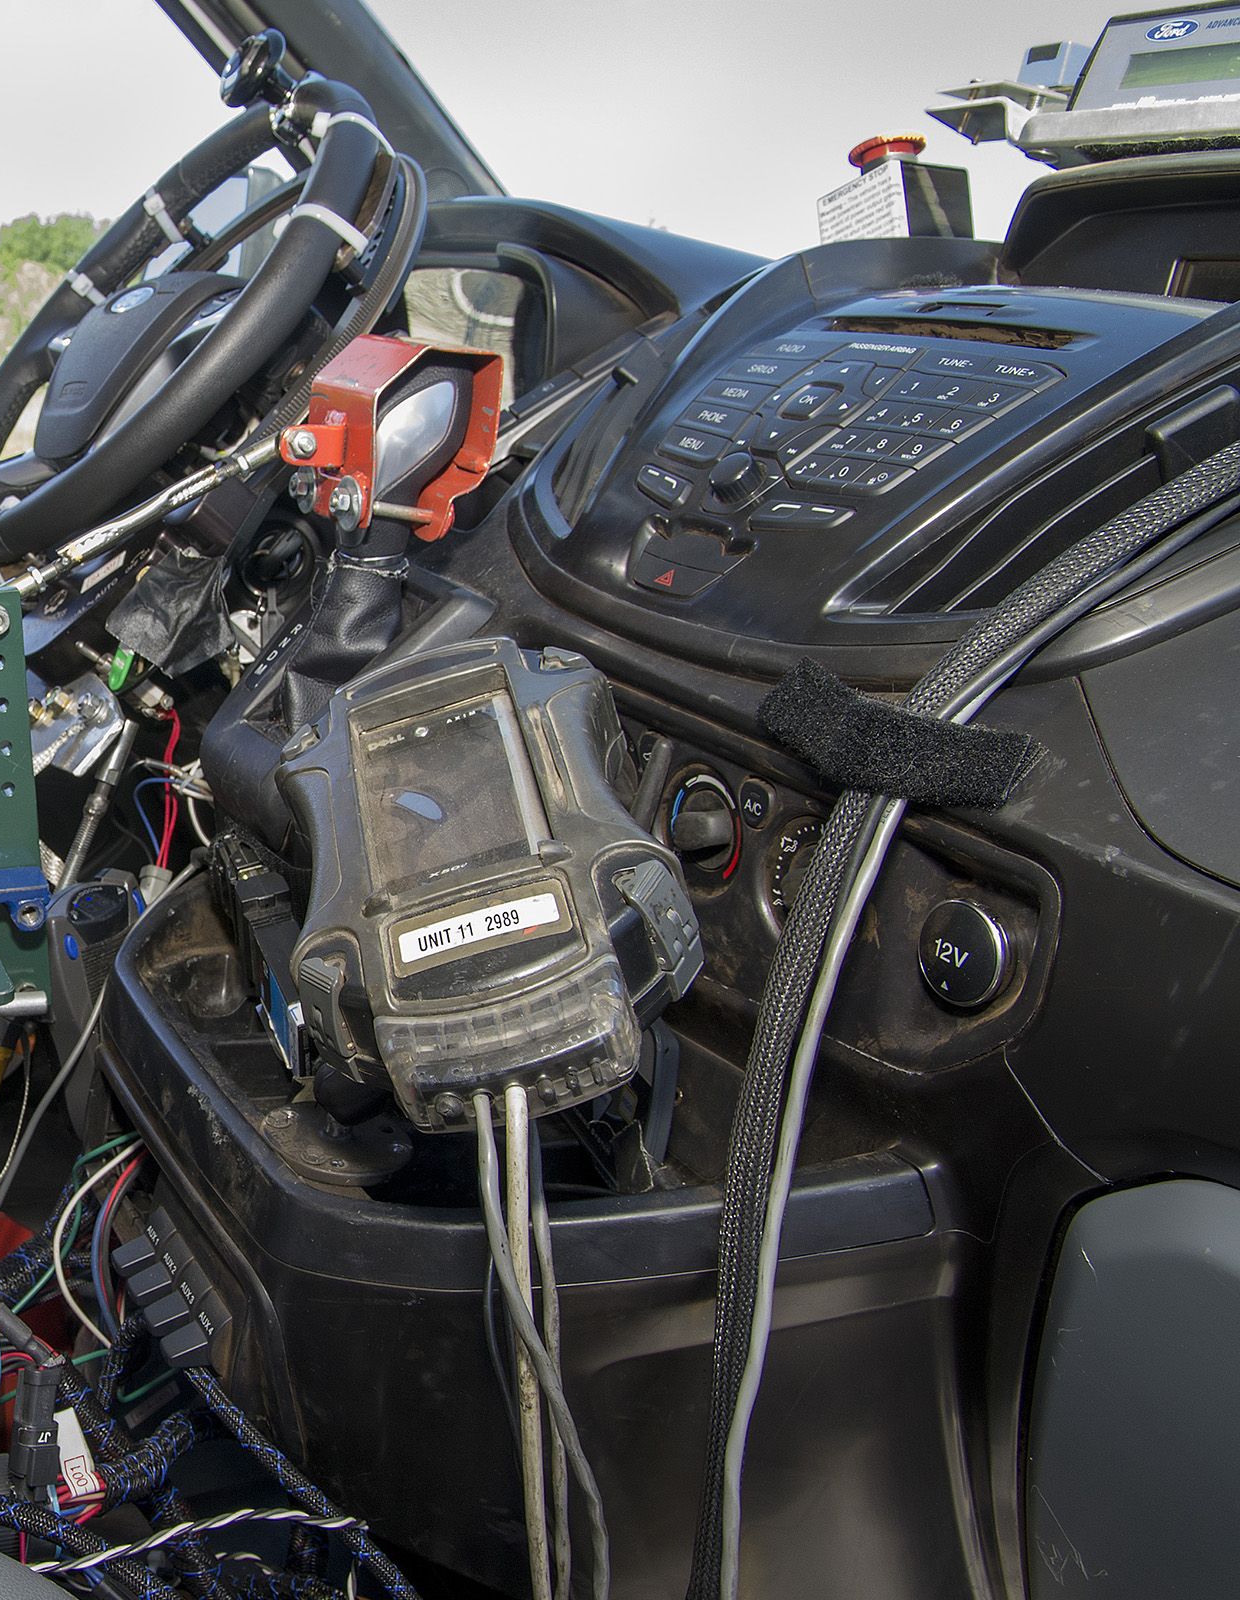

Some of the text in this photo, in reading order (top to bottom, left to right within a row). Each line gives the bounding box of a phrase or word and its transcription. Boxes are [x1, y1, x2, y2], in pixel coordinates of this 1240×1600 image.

[1206, 17, 1240, 30] ADVANC
[822, 177, 867, 206] EMERGENCY
[869, 164, 888, 181] STOP
[776, 344, 806, 353] RADIO
[848, 342, 916, 354] PASSENGER AIRBAG
[747, 364, 778, 374] SIRIUS
[995, 364, 1035, 377] TUNE+
[721, 387, 750, 398] MEDIA
[910, 382, 921, 391] 1
[946, 386, 960, 396] 2
[799, 394, 819, 405] OK
[988, 393, 1000, 403] 3
[698, 410, 728, 424] PHONE
[876, 408, 888, 418] 4
[912, 413, 924, 423] 5
[950, 419, 963, 430] 6
[678, 436, 704, 451] MENU
[845, 435, 857, 444] 7
[876, 438, 888, 449] 8
[911, 444, 923, 455] 9
[838, 466, 850, 477] 0
[95, 577, 119, 601] AUTO
[254, 623, 303, 675] R N D M
[446, 710, 476, 724] AXIM
[367, 734, 405, 752] DELL
[743, 798, 762, 816] A/C
[418, 909, 520, 952] UNIT 11 2989
[935, 938, 969, 968] 12V
[146, 1225, 157, 1242] AUX
[163, 1252, 173, 1270] AUX
[180, 1281, 192, 1300] AUX
[198, 1311, 211, 1332] AUX
[38, 1431, 52, 1443] J7
